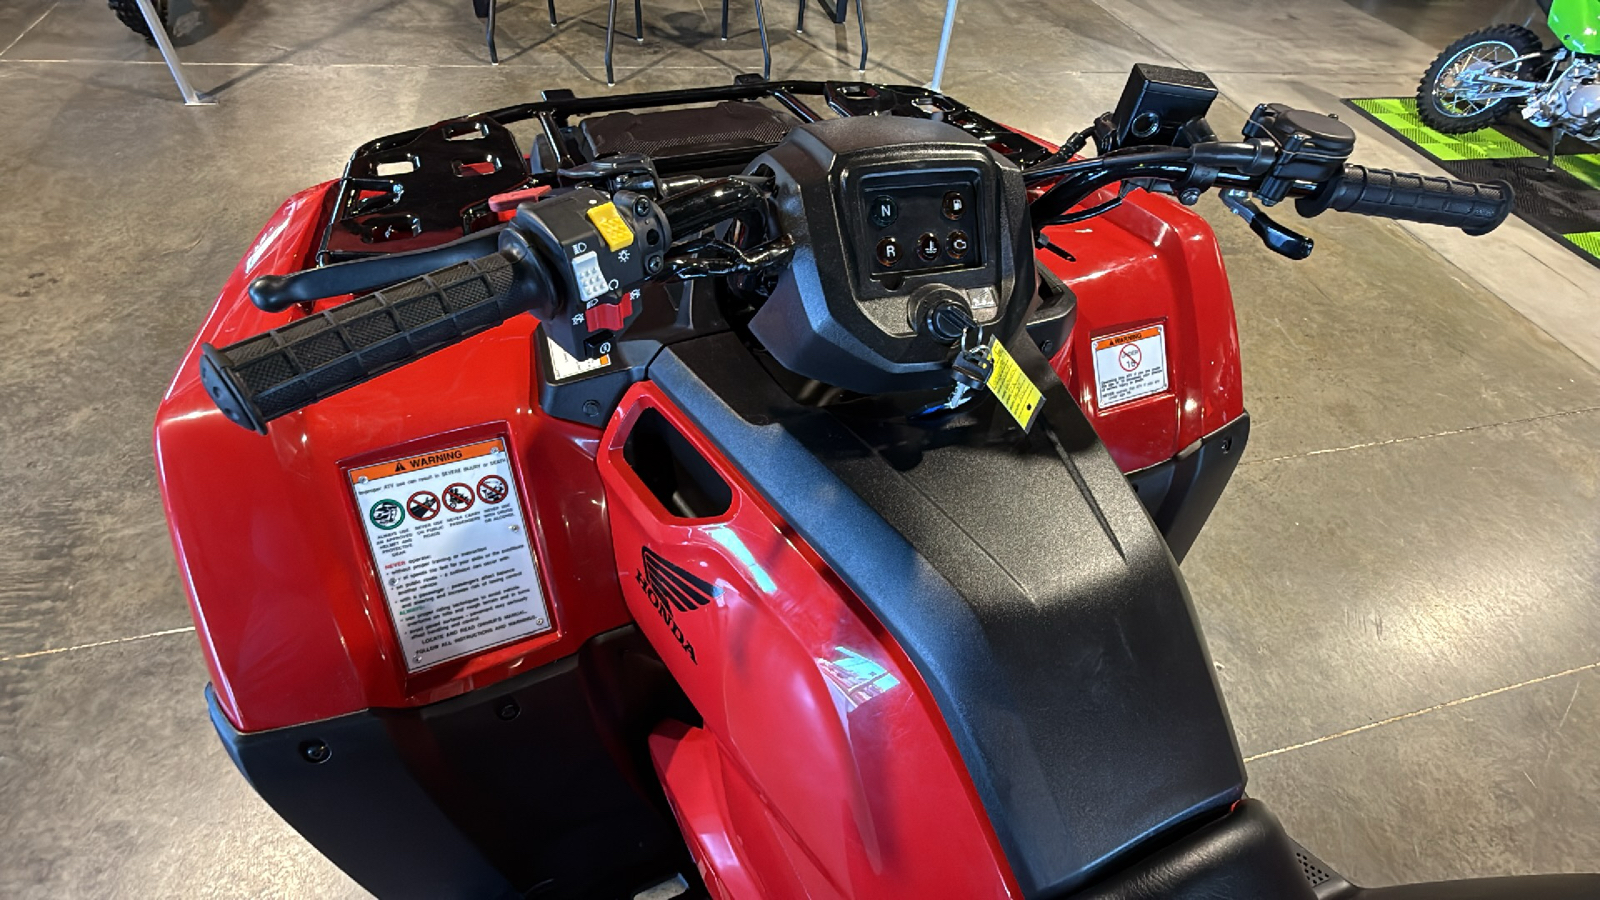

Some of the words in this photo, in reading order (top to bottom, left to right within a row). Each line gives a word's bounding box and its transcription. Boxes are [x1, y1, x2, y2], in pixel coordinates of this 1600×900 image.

[881, 204, 891, 217] N
[886, 245, 896, 257] R
[1115, 333, 1142, 344] WARNING
[409, 450, 463, 468] WARNING
[384, 560, 406, 569] NEVER
[635, 567, 698, 666] HONDA
[421, 634, 444, 644] LOCATE
[445, 629, 458, 637] AND
[459, 624, 475, 632] READ
[440, 639, 452, 647] ALL
[494, 622, 506, 630] AND
